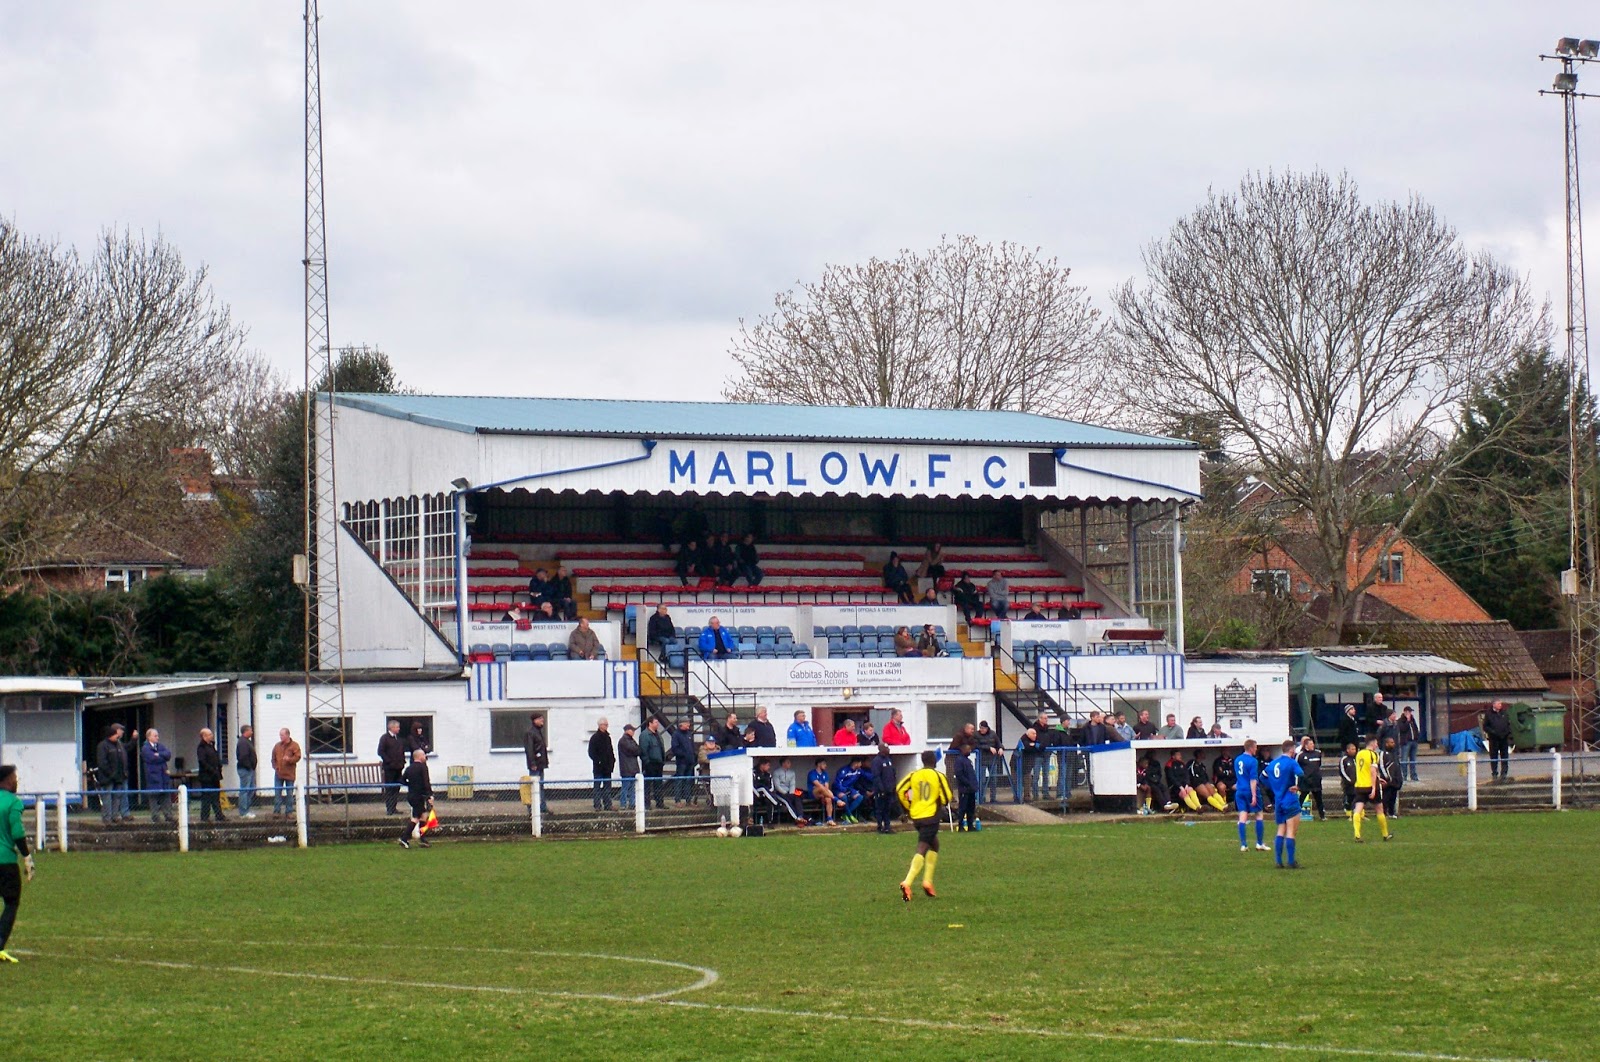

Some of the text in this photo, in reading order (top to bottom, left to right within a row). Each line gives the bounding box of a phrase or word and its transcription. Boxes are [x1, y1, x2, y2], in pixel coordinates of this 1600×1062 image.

[790, 670, 849, 679] Gabbitas Robins
[1238, 760, 1244, 775] 3
[1273, 762, 1280, 778] 6
[1358, 758, 1364, 772] 9
[919, 780, 931, 801] 10
